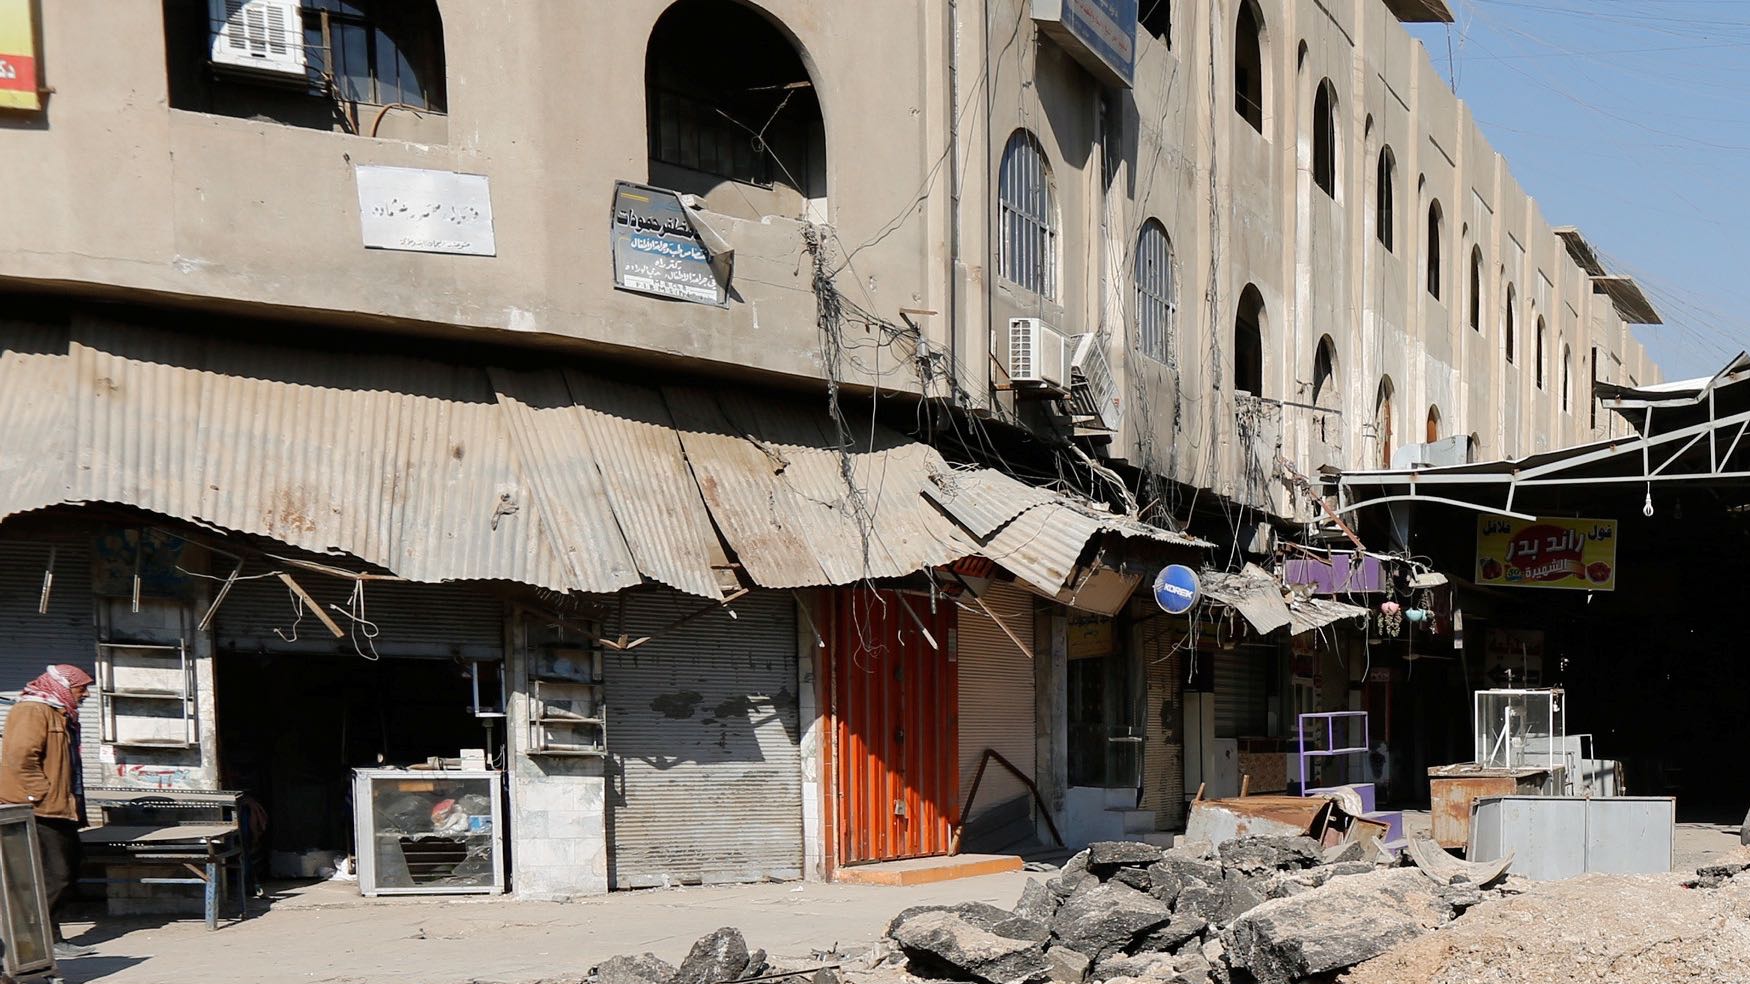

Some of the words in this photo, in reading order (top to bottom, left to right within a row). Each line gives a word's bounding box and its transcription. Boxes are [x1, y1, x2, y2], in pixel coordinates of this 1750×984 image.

[1588, 523, 1613, 541] فول
[1504, 538, 1540, 561] بدر
[1525, 558, 1568, 580] الشهيرة
[1164, 583, 1193, 599] KOREK
